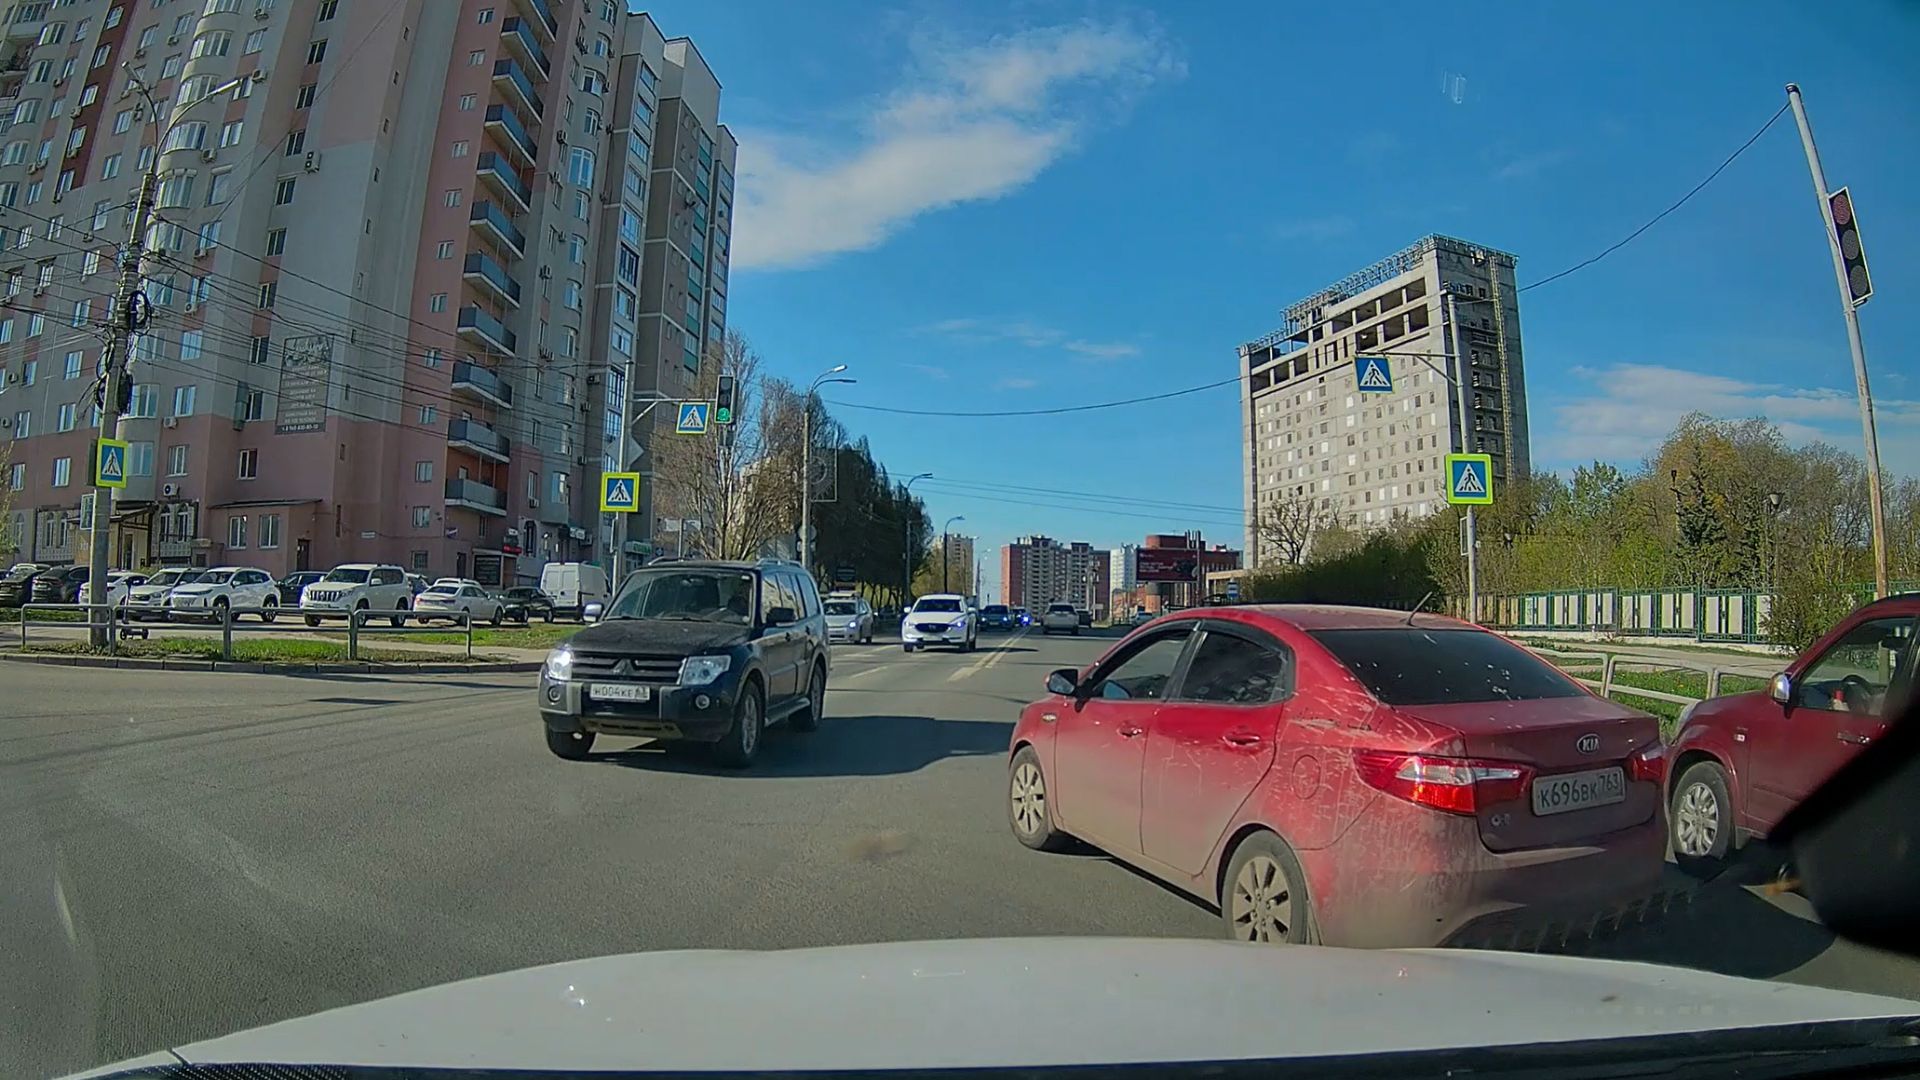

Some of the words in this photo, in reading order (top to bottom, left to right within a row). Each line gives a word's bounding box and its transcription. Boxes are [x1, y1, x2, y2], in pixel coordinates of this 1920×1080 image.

[1582, 737, 1600, 751] KIA
[1540, 780, 1598, 808] К696ВК
[1599, 773, 1619, 791] 763
